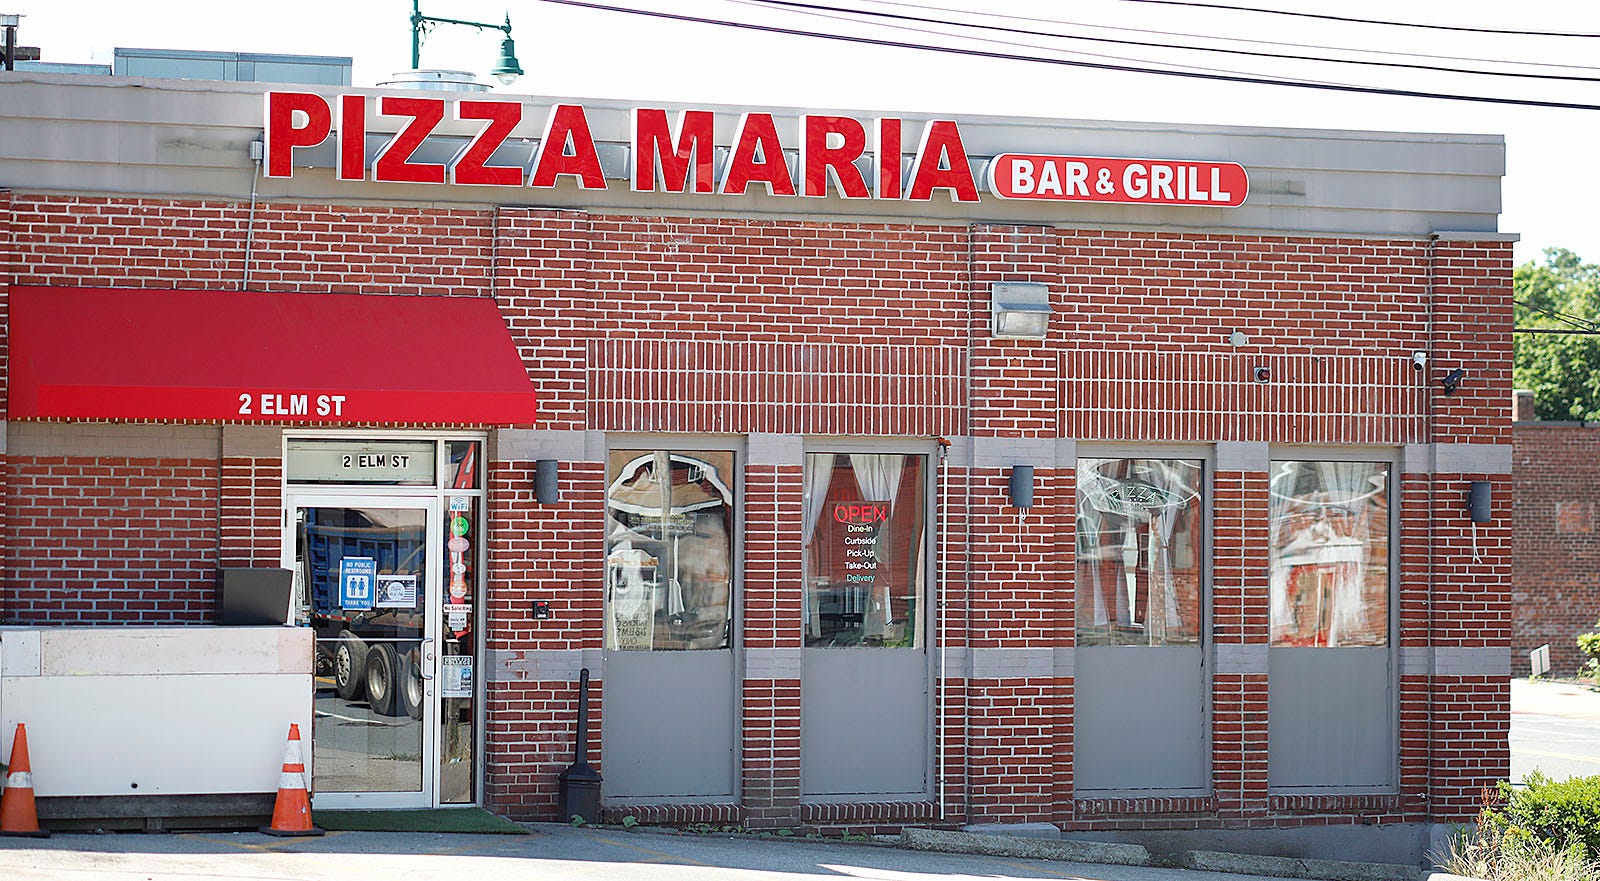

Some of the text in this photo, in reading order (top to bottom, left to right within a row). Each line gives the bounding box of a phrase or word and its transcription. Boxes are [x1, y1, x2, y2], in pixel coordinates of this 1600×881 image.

[263, 90, 981, 203] PIZZA MARIA
[1011, 159, 1231, 202] BAR & GRILL
[238, 393, 346, 416] 2 ELM ST
[343, 455, 410, 468] 2 ELM ST
[834, 505, 887, 523] OPEN
[847, 524, 873, 533] Dine-In
[844, 537, 877, 545] Curbside
[847, 549, 875, 558] Pick-Up
[845, 562, 877, 570] Take-Out
[846, 574, 876, 584] Delivery
